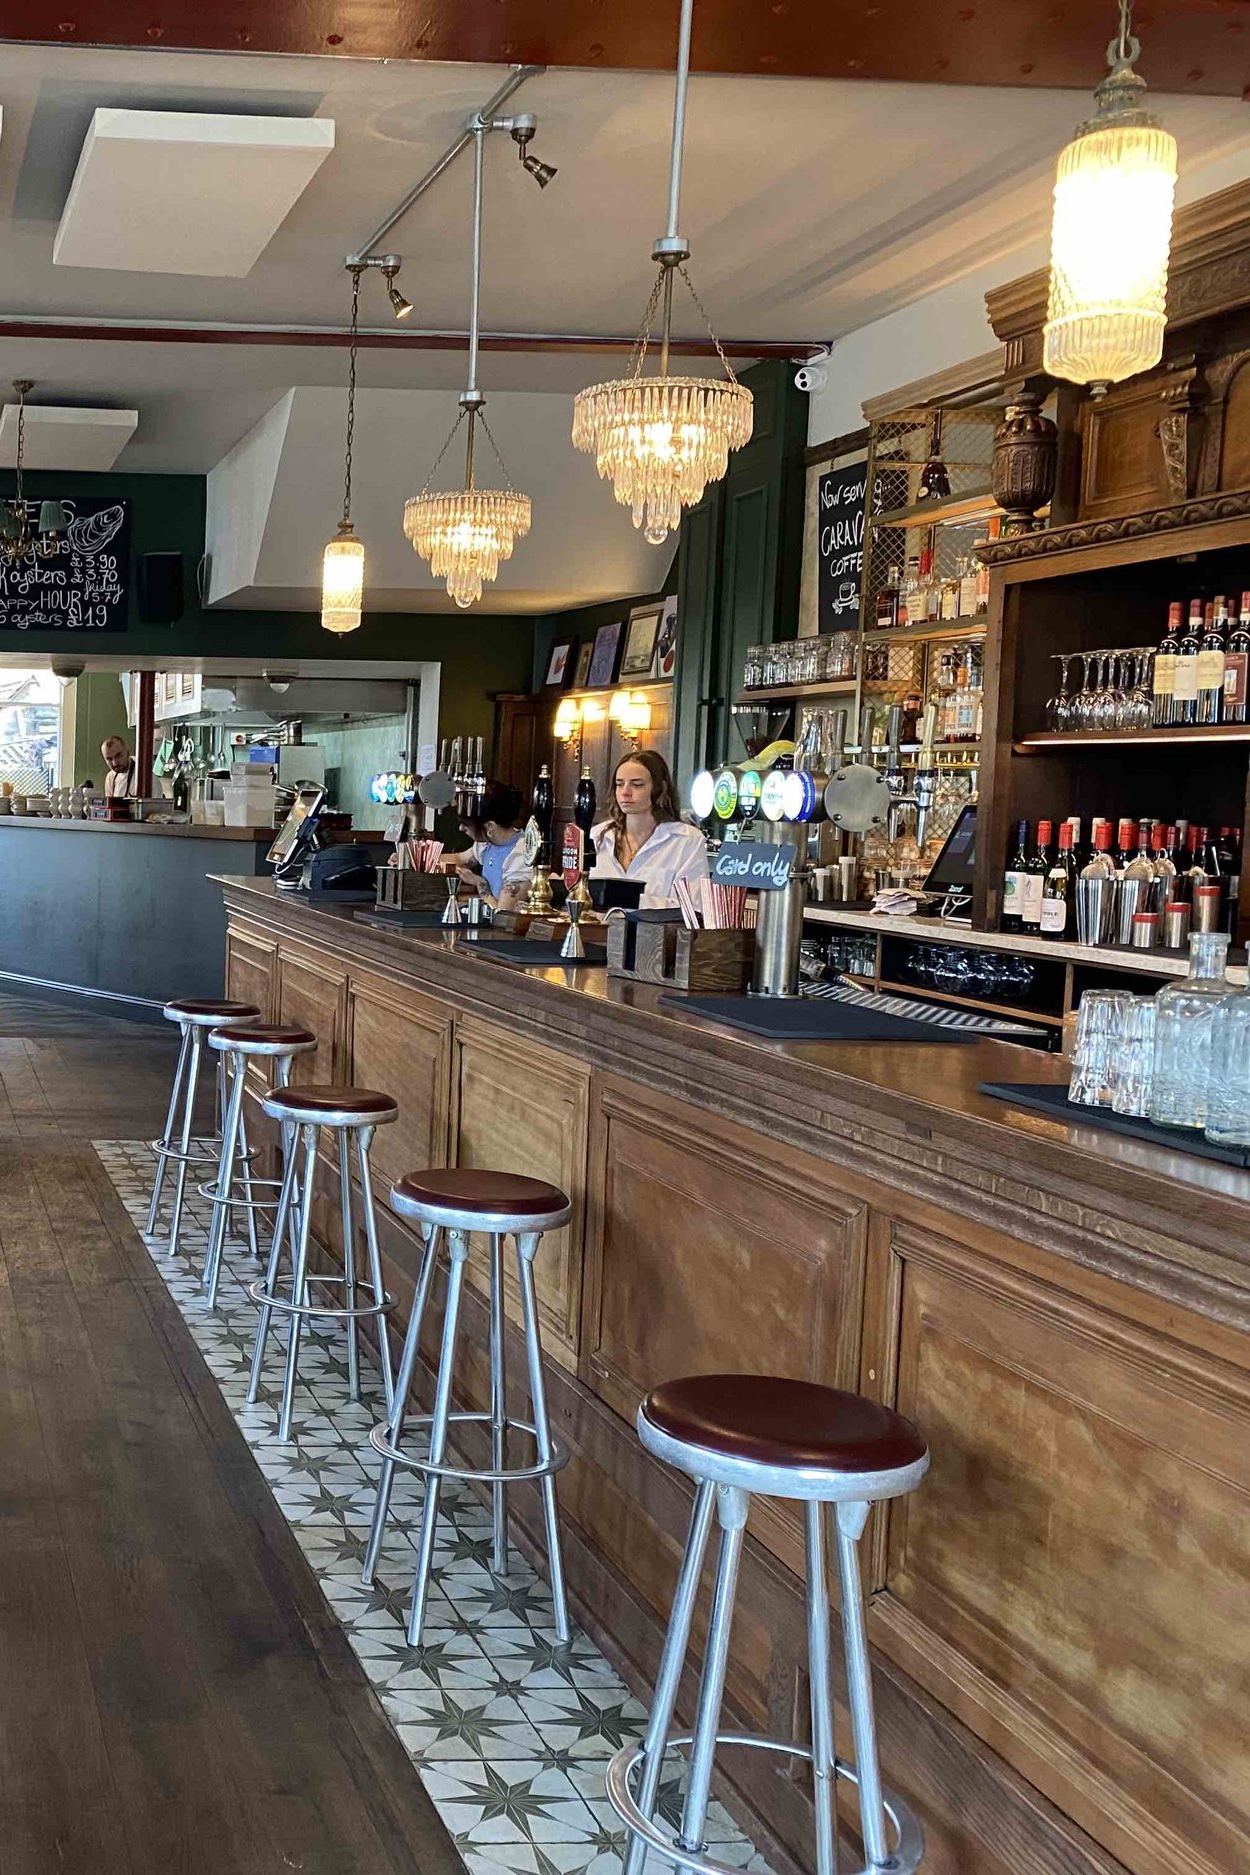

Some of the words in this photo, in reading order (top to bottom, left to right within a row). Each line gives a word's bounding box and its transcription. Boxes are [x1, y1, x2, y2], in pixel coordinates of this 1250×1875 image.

[821, 480, 843, 511] Now
[10, 562, 67, 594] oysters
[830, 551, 864, 578] COFFE
[11, 610, 63, 630] oysters
[40, 590, 82, 622] HOUR
[716, 854, 752, 876] Card
[752, 852, 790, 887] only
